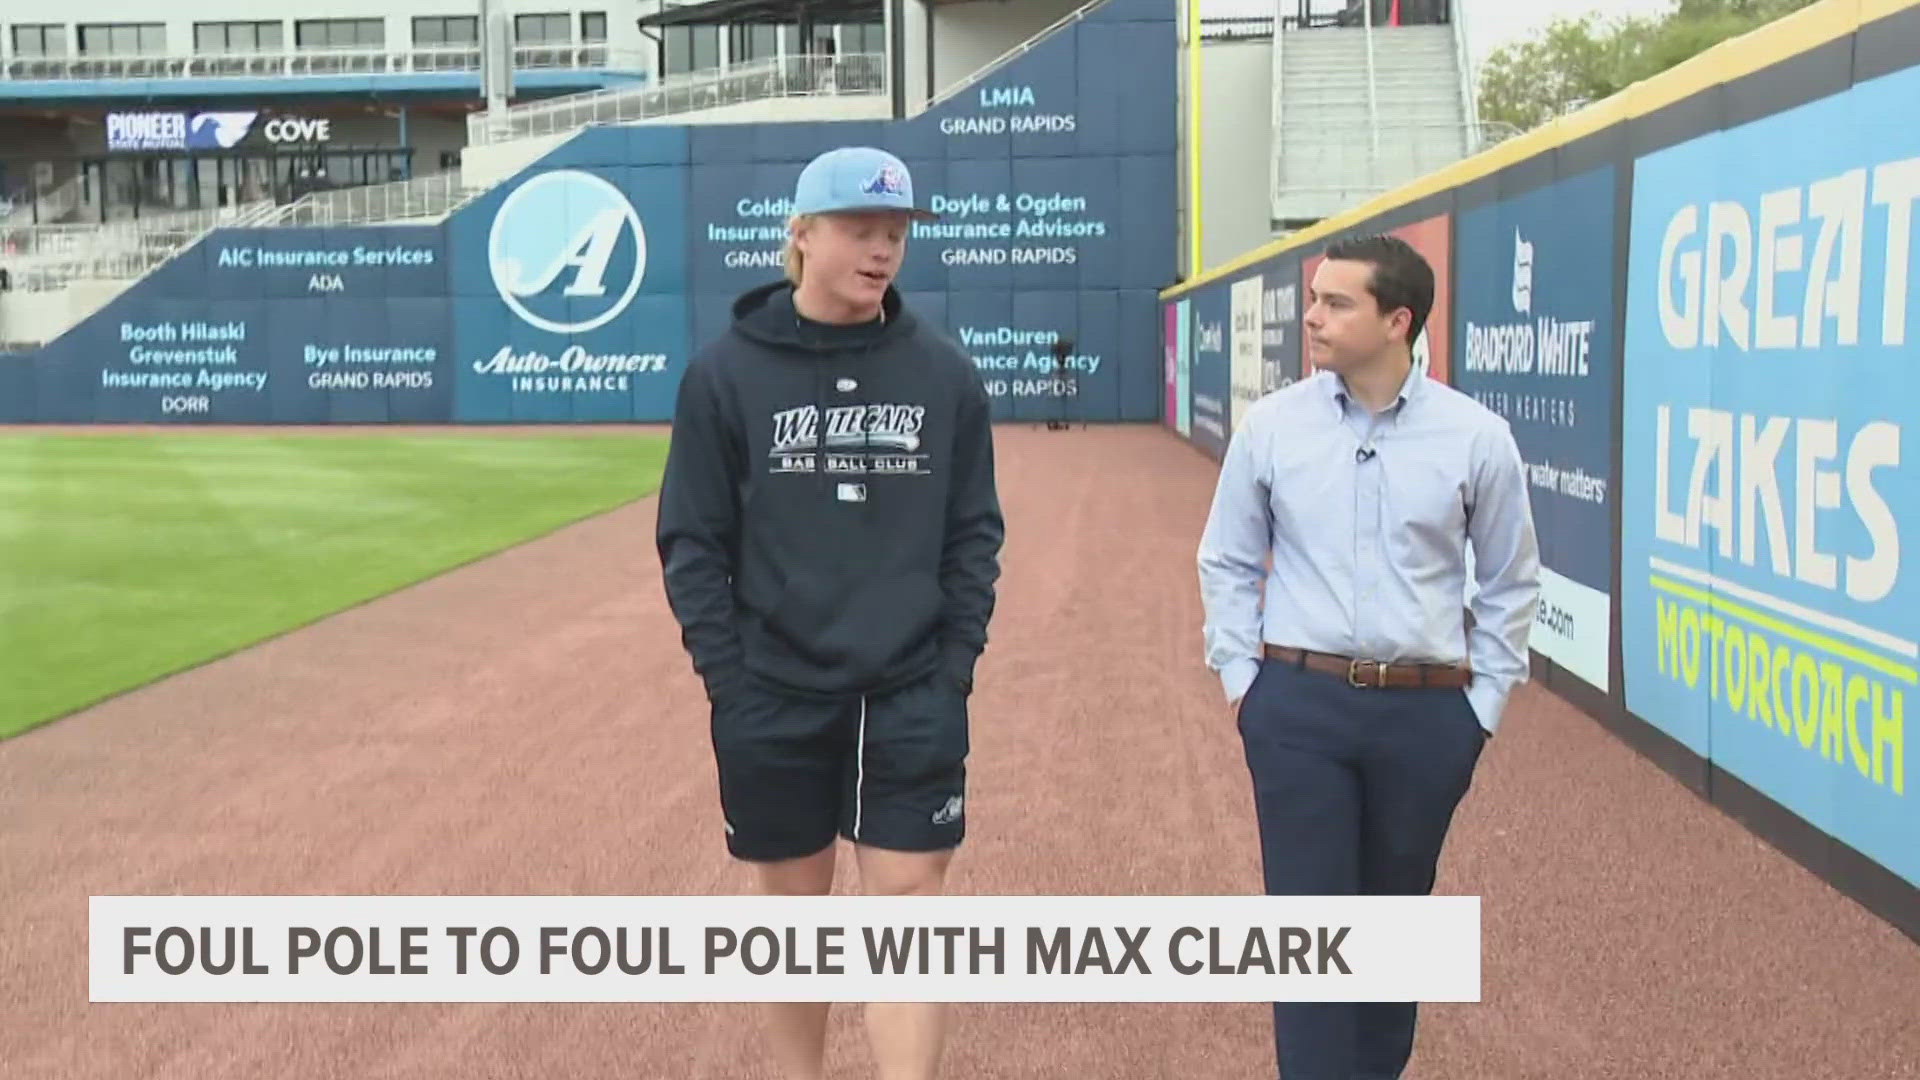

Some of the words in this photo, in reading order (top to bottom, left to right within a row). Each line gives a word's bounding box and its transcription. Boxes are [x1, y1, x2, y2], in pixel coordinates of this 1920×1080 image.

[980, 87, 1035, 107] LMIA
[107, 113, 186, 139] PIONEER
[264, 119, 330, 142] COVE
[940, 117, 1006, 134] GRAND
[1010, 115, 1076, 132] RAPIDS
[736, 197, 796, 217] Coldb
[931, 194, 990, 217] Doyle
[995, 194, 1011, 213] &
[1015, 193, 1086, 216] Ogden
[708, 222, 793, 241] Insuranc
[912, 221, 1011, 239] Insurance
[1015, 219, 1105, 238] Advisors
[218, 248, 252, 267] AIC
[257, 248, 349, 266] Insurance
[354, 247, 434, 265] Services
[941, 248, 1007, 265] GRAND
[1011, 246, 1077, 264] RAPIDS
[1657, 156, 1920, 352] GREAT
[307, 275, 344, 292] ADA
[120, 322, 176, 341] Booth
[181, 321, 245, 341] Hilaski
[959, 326, 1059, 347] VanDuren
[129, 344, 237, 364] Grevenstuk
[303, 345, 339, 368] Bye
[344, 344, 437, 363] Insurance
[1465, 322, 1534, 374] BRADFORD
[1537, 316, 1589, 377] WHITE
[472, 344, 669, 376] Auto-Owners
[102, 368, 193, 388] Insurance
[196, 368, 267, 392] Agency
[308, 372, 369, 390] GRAND
[373, 372, 433, 389] RAPIDS
[511, 375, 630, 393] INSURANCE
[161, 395, 210, 413] DORR
[1516, 393, 1576, 428] HEATERS
[1531, 461, 1560, 491] water
[1560, 468, 1604, 505] matters
[1655, 404, 1900, 604] LAKES
[1656, 596, 1904, 796] MOTORCOACH
